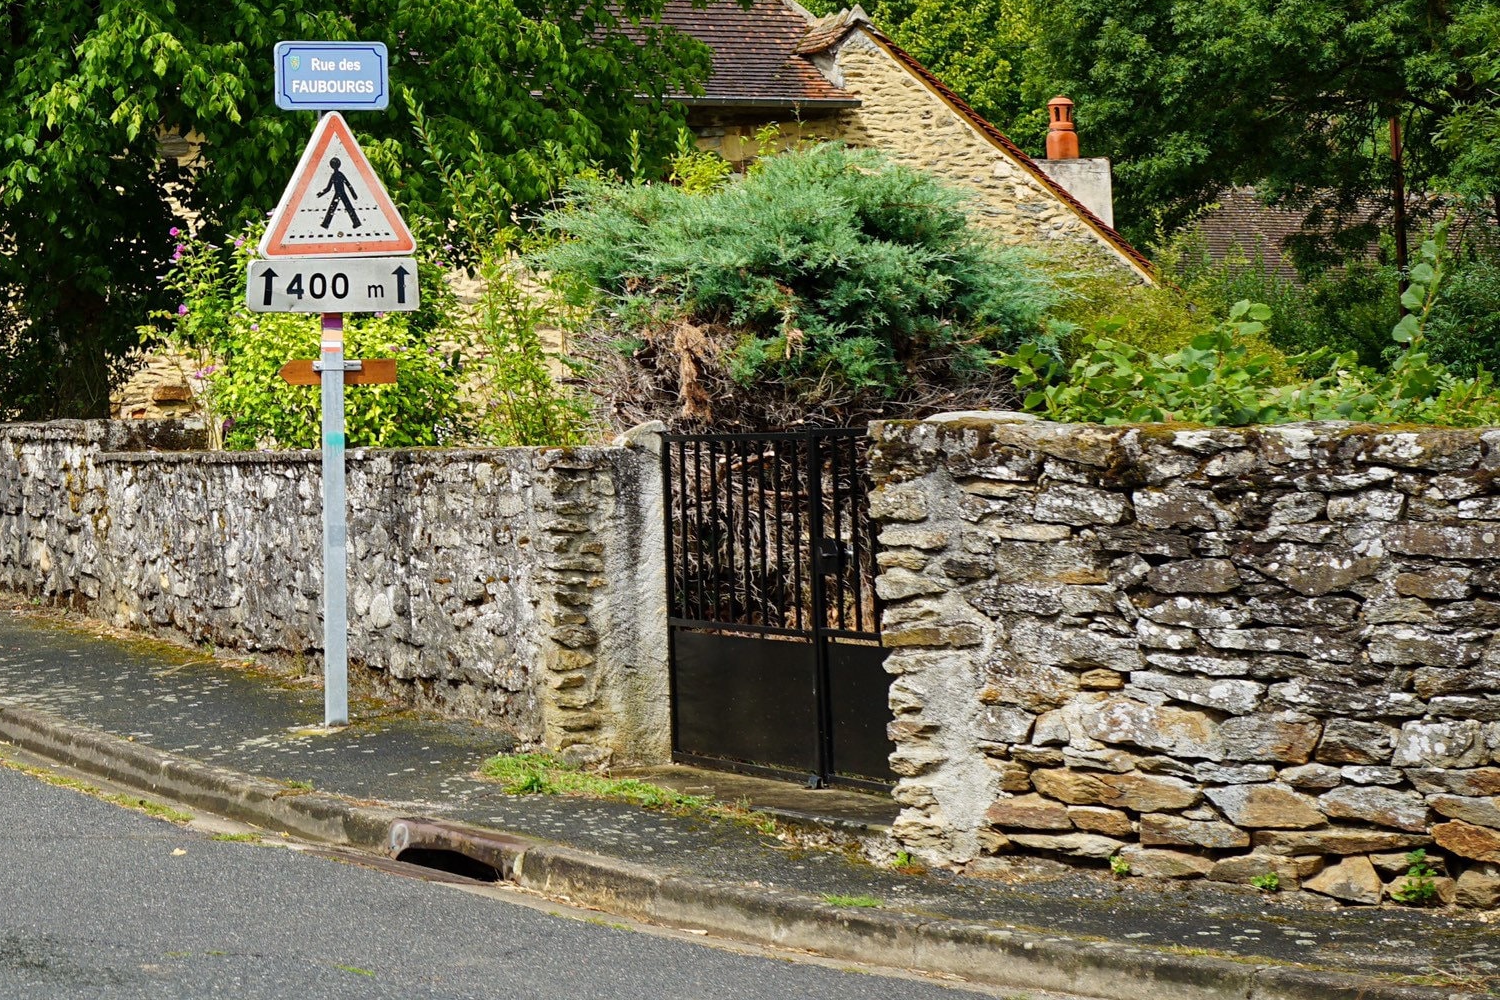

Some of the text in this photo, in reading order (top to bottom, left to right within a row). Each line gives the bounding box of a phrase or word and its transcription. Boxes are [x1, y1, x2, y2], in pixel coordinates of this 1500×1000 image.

[311, 57, 361, 71] Rue des
[292, 80, 374, 93] FAUBOURGS
[286, 273, 384, 300] 400 m
